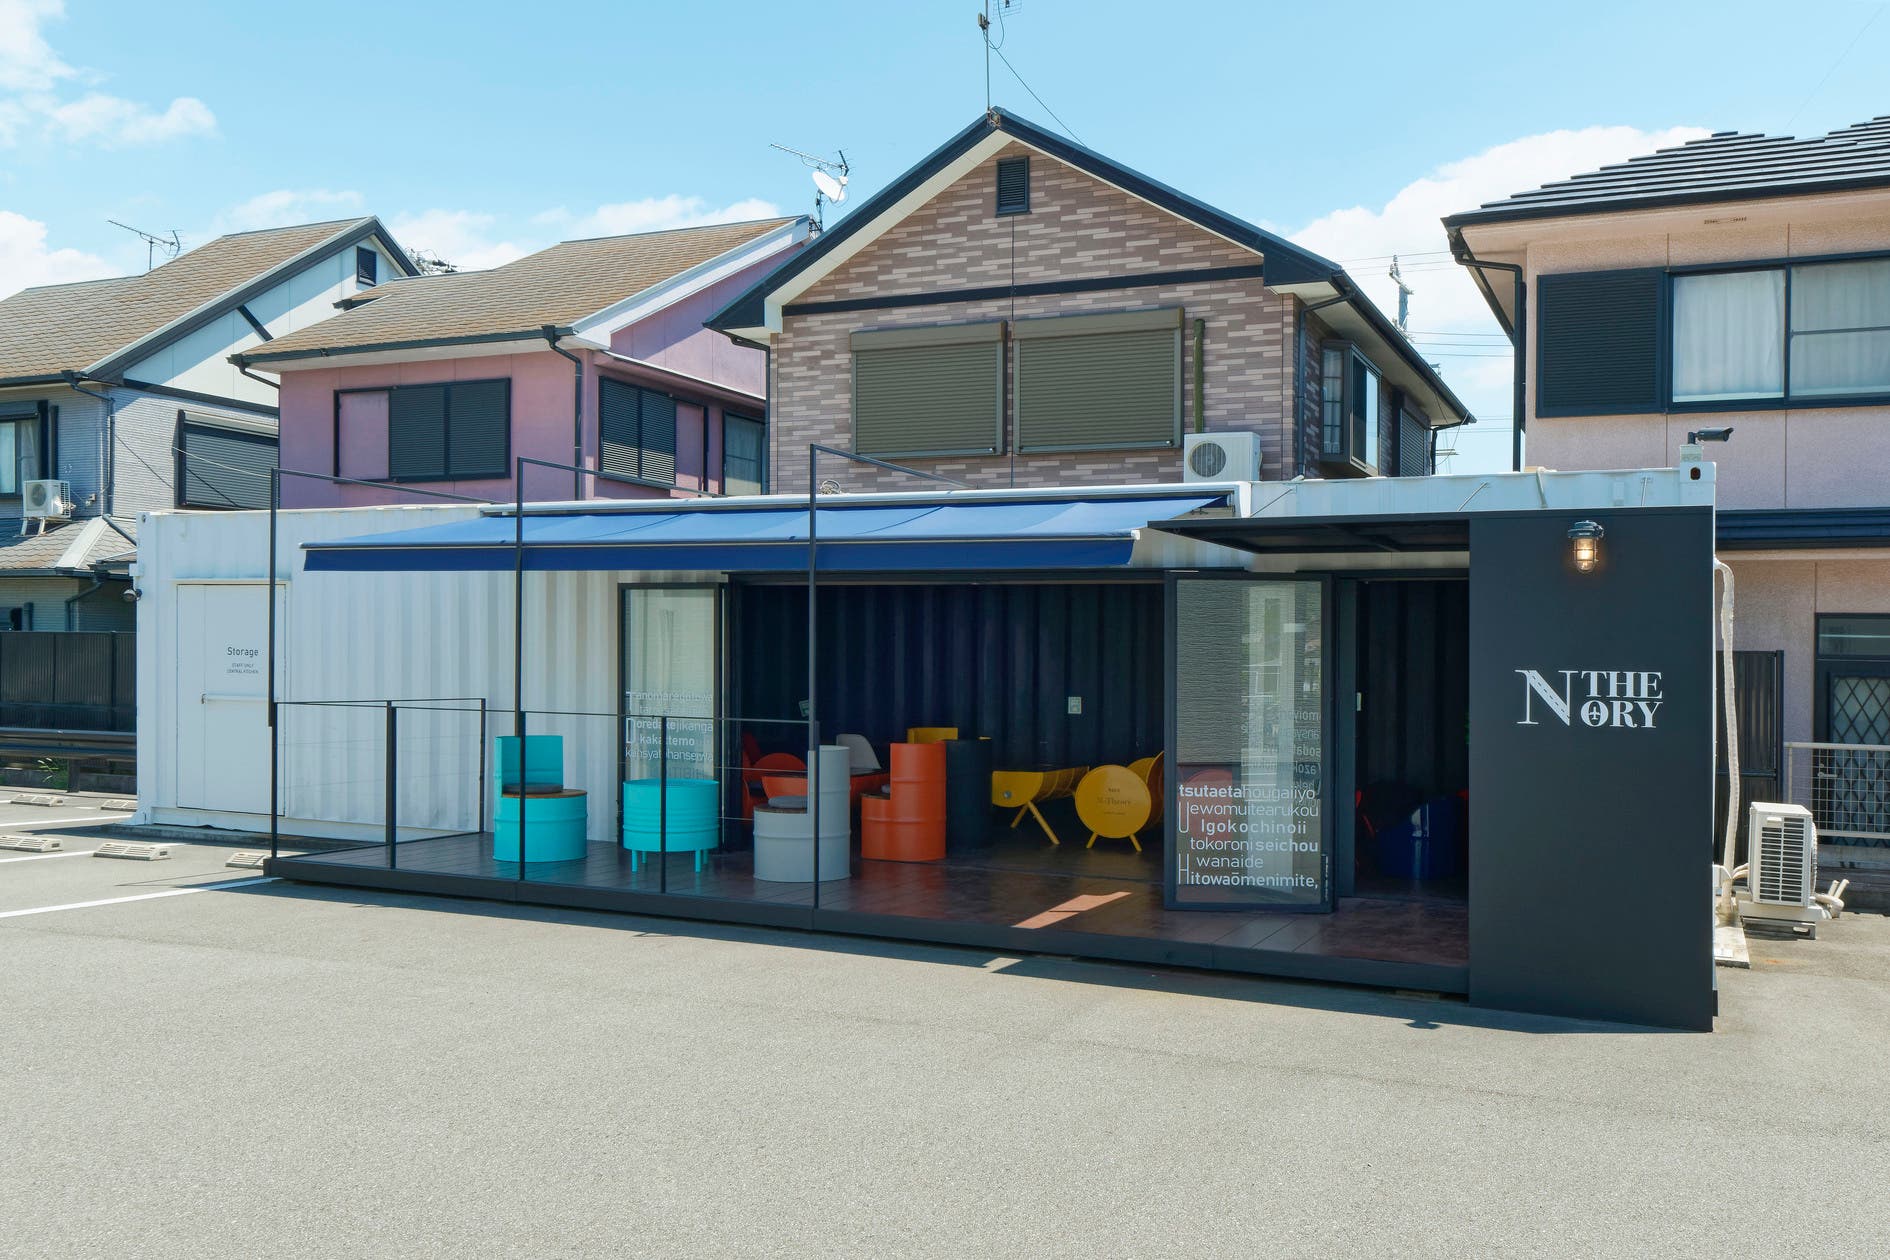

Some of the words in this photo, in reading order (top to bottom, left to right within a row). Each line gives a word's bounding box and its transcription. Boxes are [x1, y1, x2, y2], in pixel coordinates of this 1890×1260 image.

[227, 646, 259, 658] Storage
[1514, 669, 1579, 726] N
[1580, 671, 1663, 699] THE
[1580, 700, 1663, 728] ORY
[1195, 854, 1264, 868] wanaide
